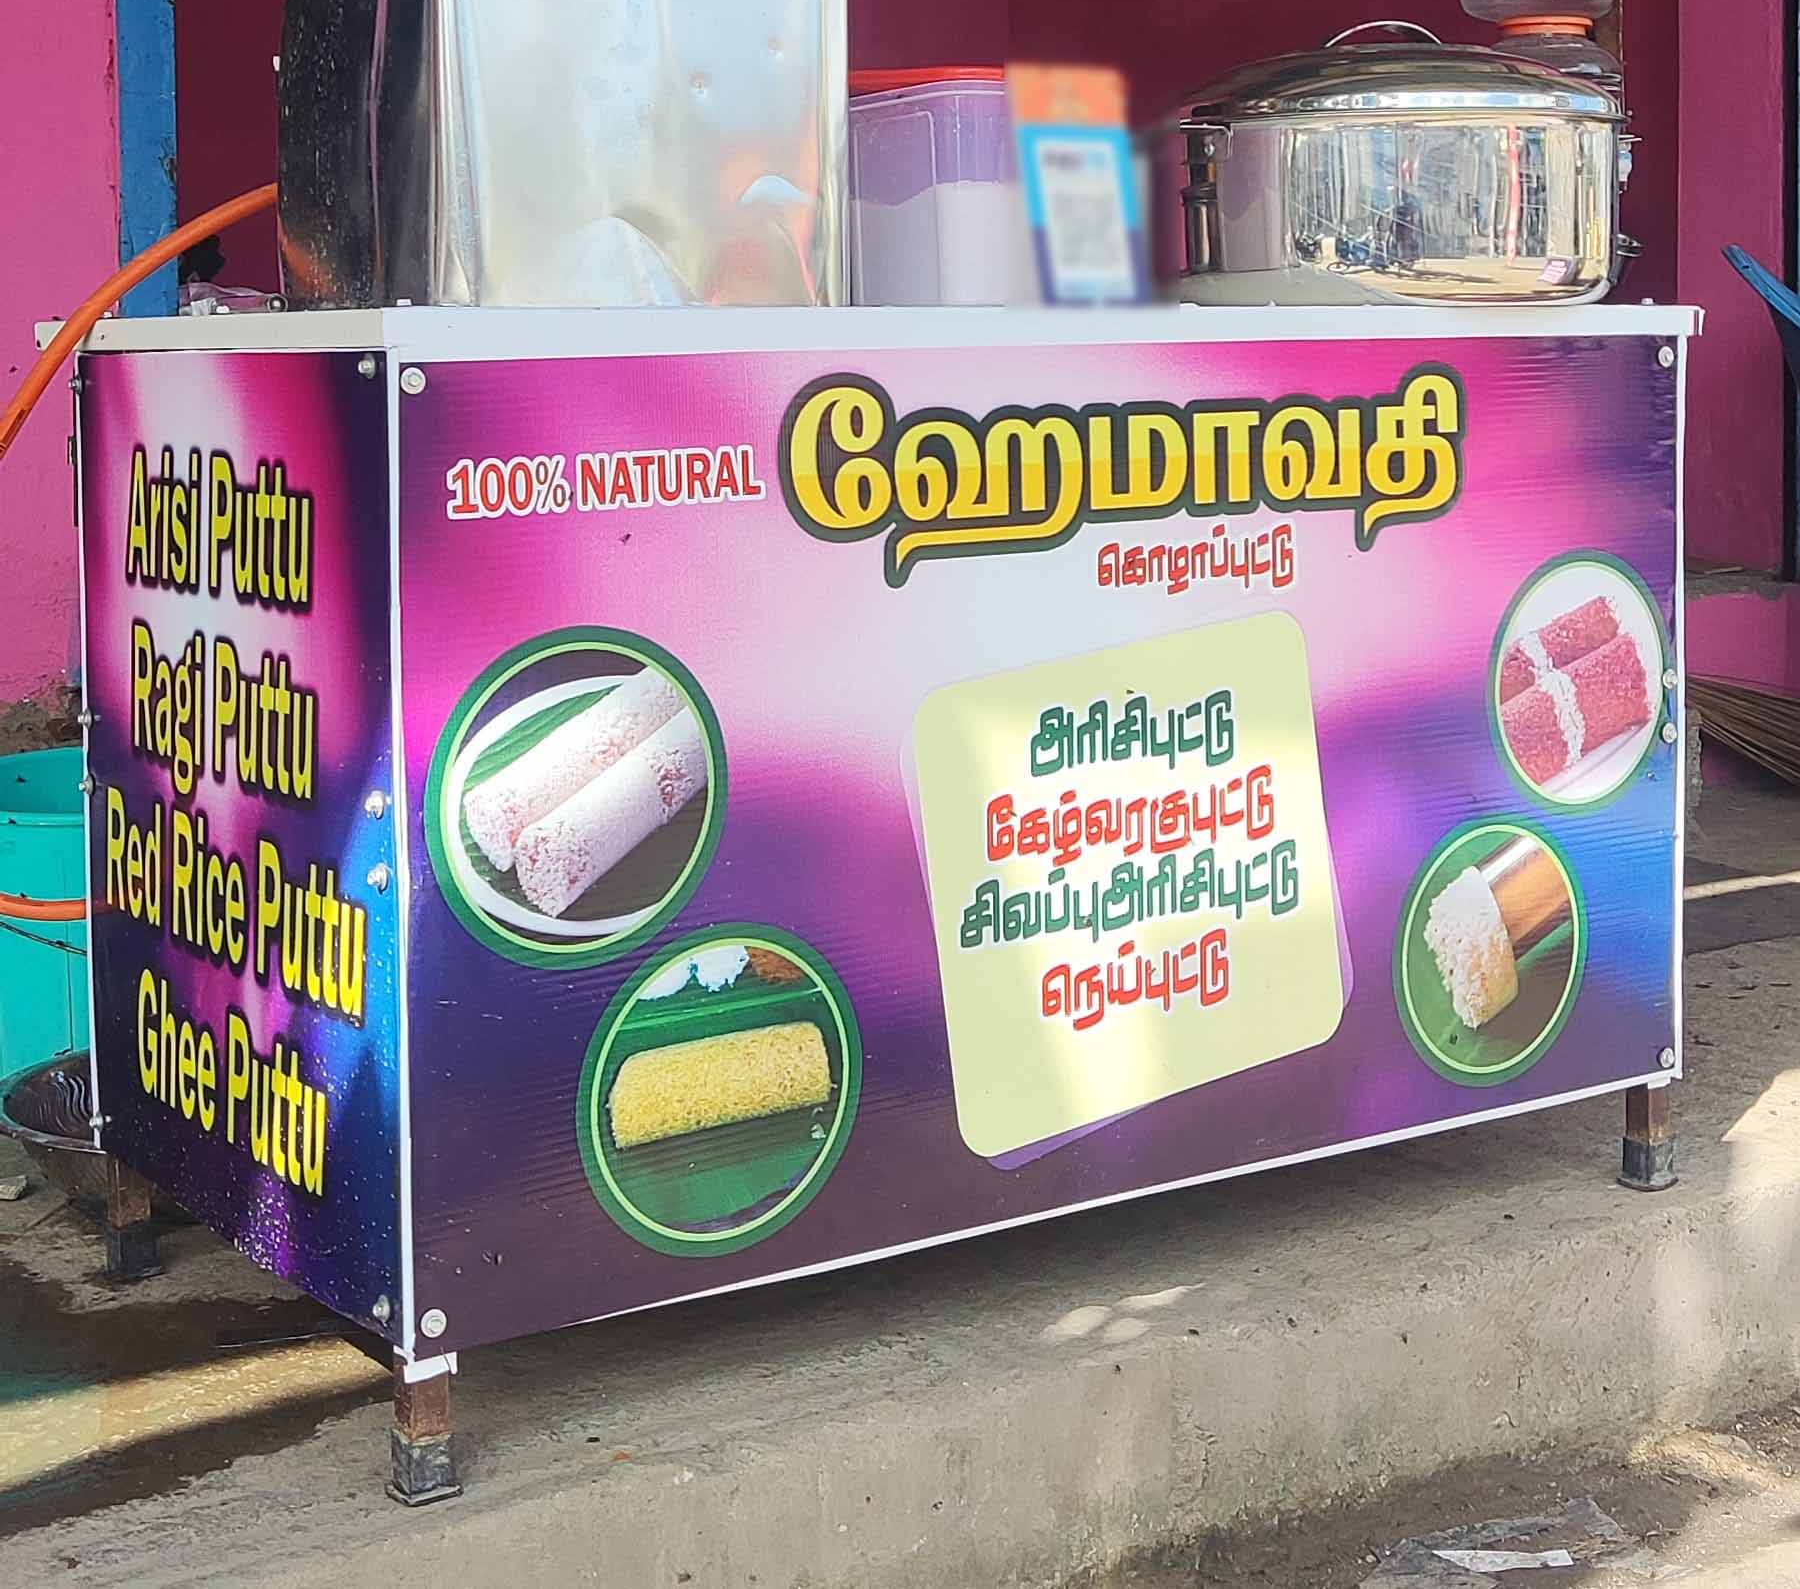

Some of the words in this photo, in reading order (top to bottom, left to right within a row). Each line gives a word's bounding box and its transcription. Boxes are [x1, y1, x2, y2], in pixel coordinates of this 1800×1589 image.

[128, 450, 203, 586] Arisi
[208, 455, 312, 603] Puttu
[451, 460, 569, 514] 100%
[579, 449, 762, 507] NATURAL
[791, 374, 1459, 570] ஹேமாவதி
[1097, 523, 1294, 595] கொழாப்புட்டு
[133, 624, 204, 792] Ragi
[213, 642, 314, 799] Puttu
[1030, 689, 1235, 777] அரிசிபுட்டு
[987, 764, 1275, 867] கேழ்வரகுபுட்டு
[107, 787, 161, 927] Red
[172, 809, 245, 965] Rice
[257, 840, 366, 1016] Puttu
[1042, 928, 1230, 1031] நெய்புட்டு
[137, 968, 216, 1131] Ghee
[227, 1012, 327, 1197] Puttu
